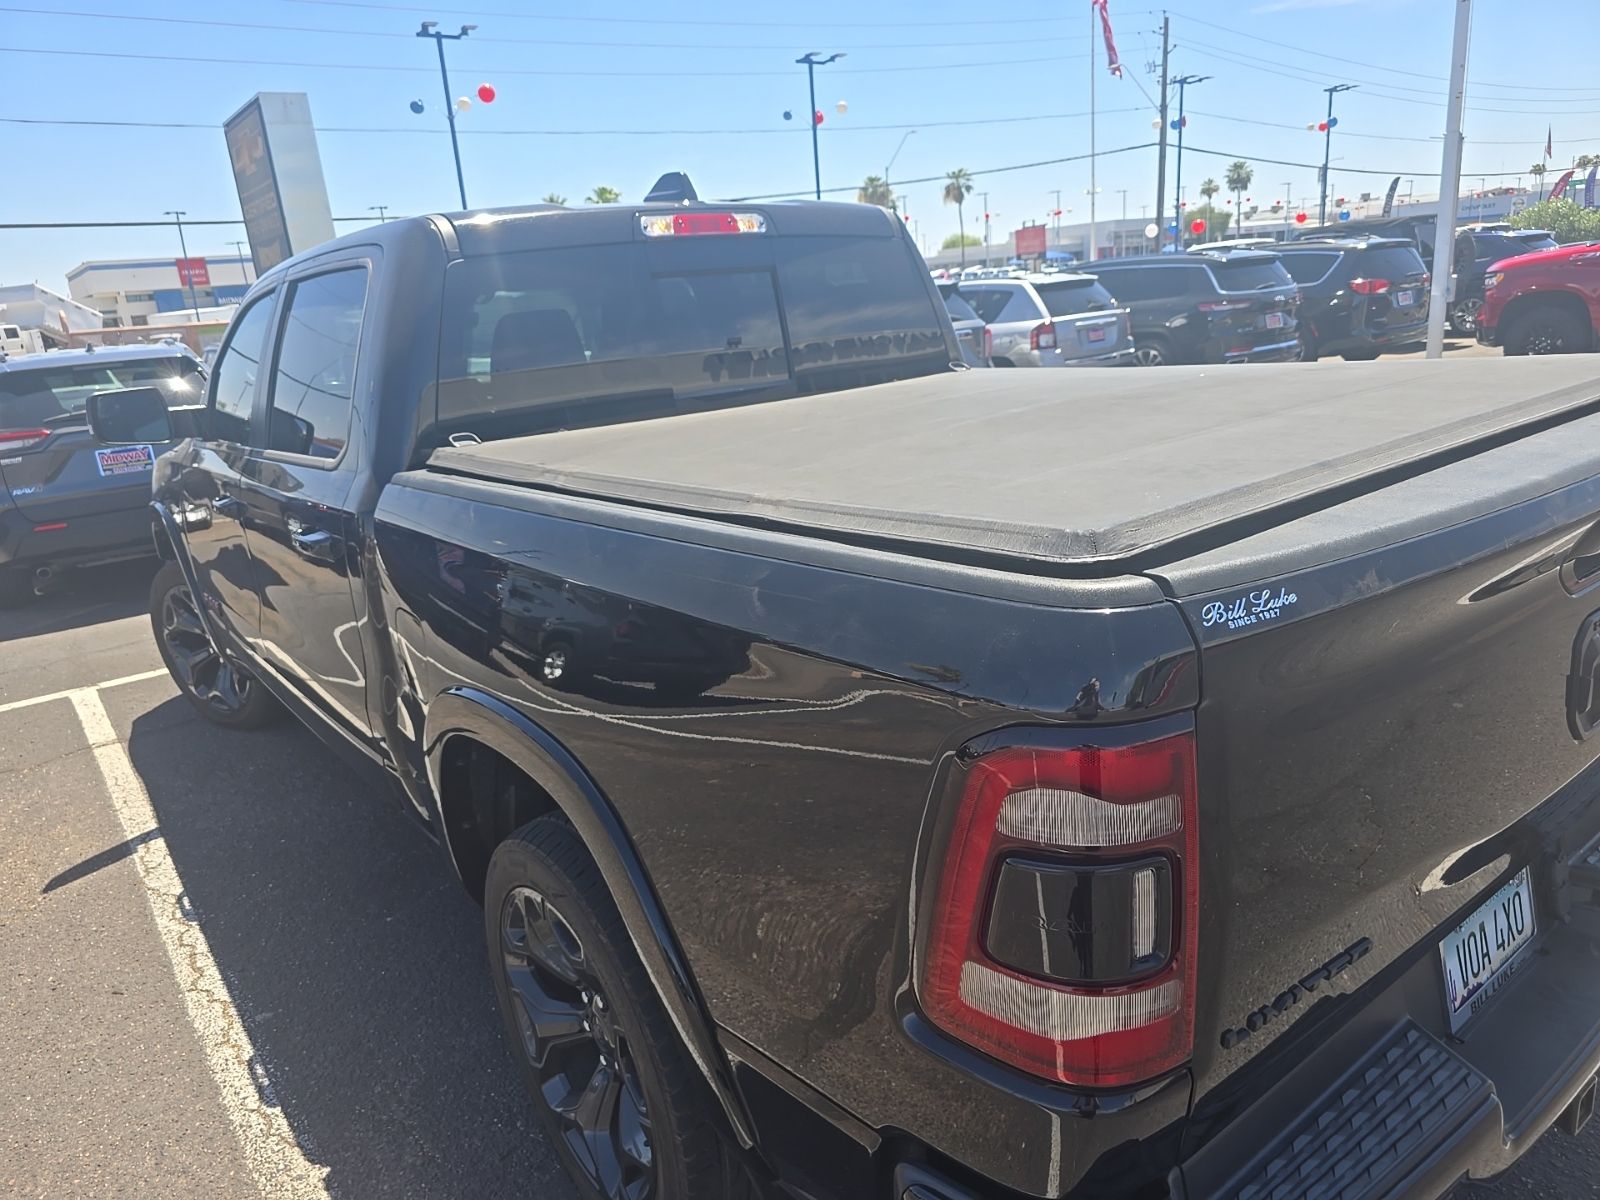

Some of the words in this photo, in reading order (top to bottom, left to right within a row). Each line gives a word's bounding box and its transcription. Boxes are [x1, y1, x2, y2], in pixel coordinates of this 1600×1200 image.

[218, 296, 242, 305] MIDW
[100, 448, 149, 465] MIDWAY
[1202, 598, 1246, 627] Bill
[1250, 587, 1298, 613] Luke
[1228, 615, 1257, 629] SINCE
[1259, 608, 1281, 621] 1927
[1471, 985, 1491, 1015] BILL
[1492, 963, 1517, 994] LUKE
